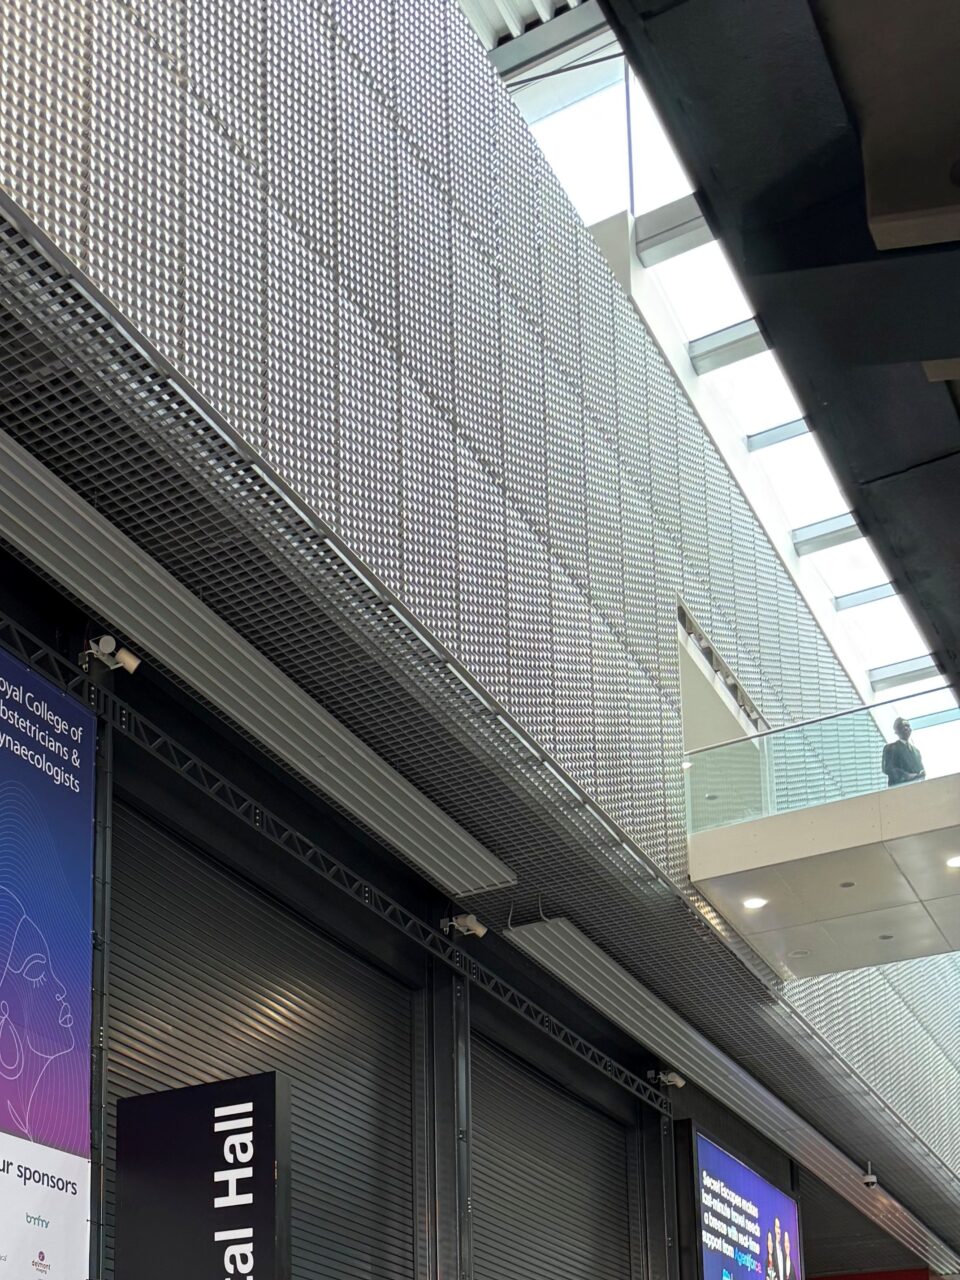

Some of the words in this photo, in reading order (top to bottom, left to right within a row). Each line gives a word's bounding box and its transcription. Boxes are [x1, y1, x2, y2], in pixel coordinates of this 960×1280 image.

[26, 693, 68, 735] College
[71, 727, 83, 743] of
[72, 751, 80, 768] &
[214, 1101, 254, 1208] Hall
[17, 1164, 78, 1195] sponsors
[702, 1170, 720, 1194] Secret
[720, 1182, 741, 1207] Escapes
[742, 1198, 758, 1218] makes
[702, 1189, 730, 1219] last-minute
[731, 1207, 745, 1227] travel
[745, 1218, 760, 1237] needs
[704, 1212, 708, 1225] a
[709, 1211, 727, 1235] breeze
[727, 1226, 738, 1242] with
[739, 1233, 760, 1254] real-time
[702, 1230, 722, 1250] support
[722, 1239, 734, 1259] from
